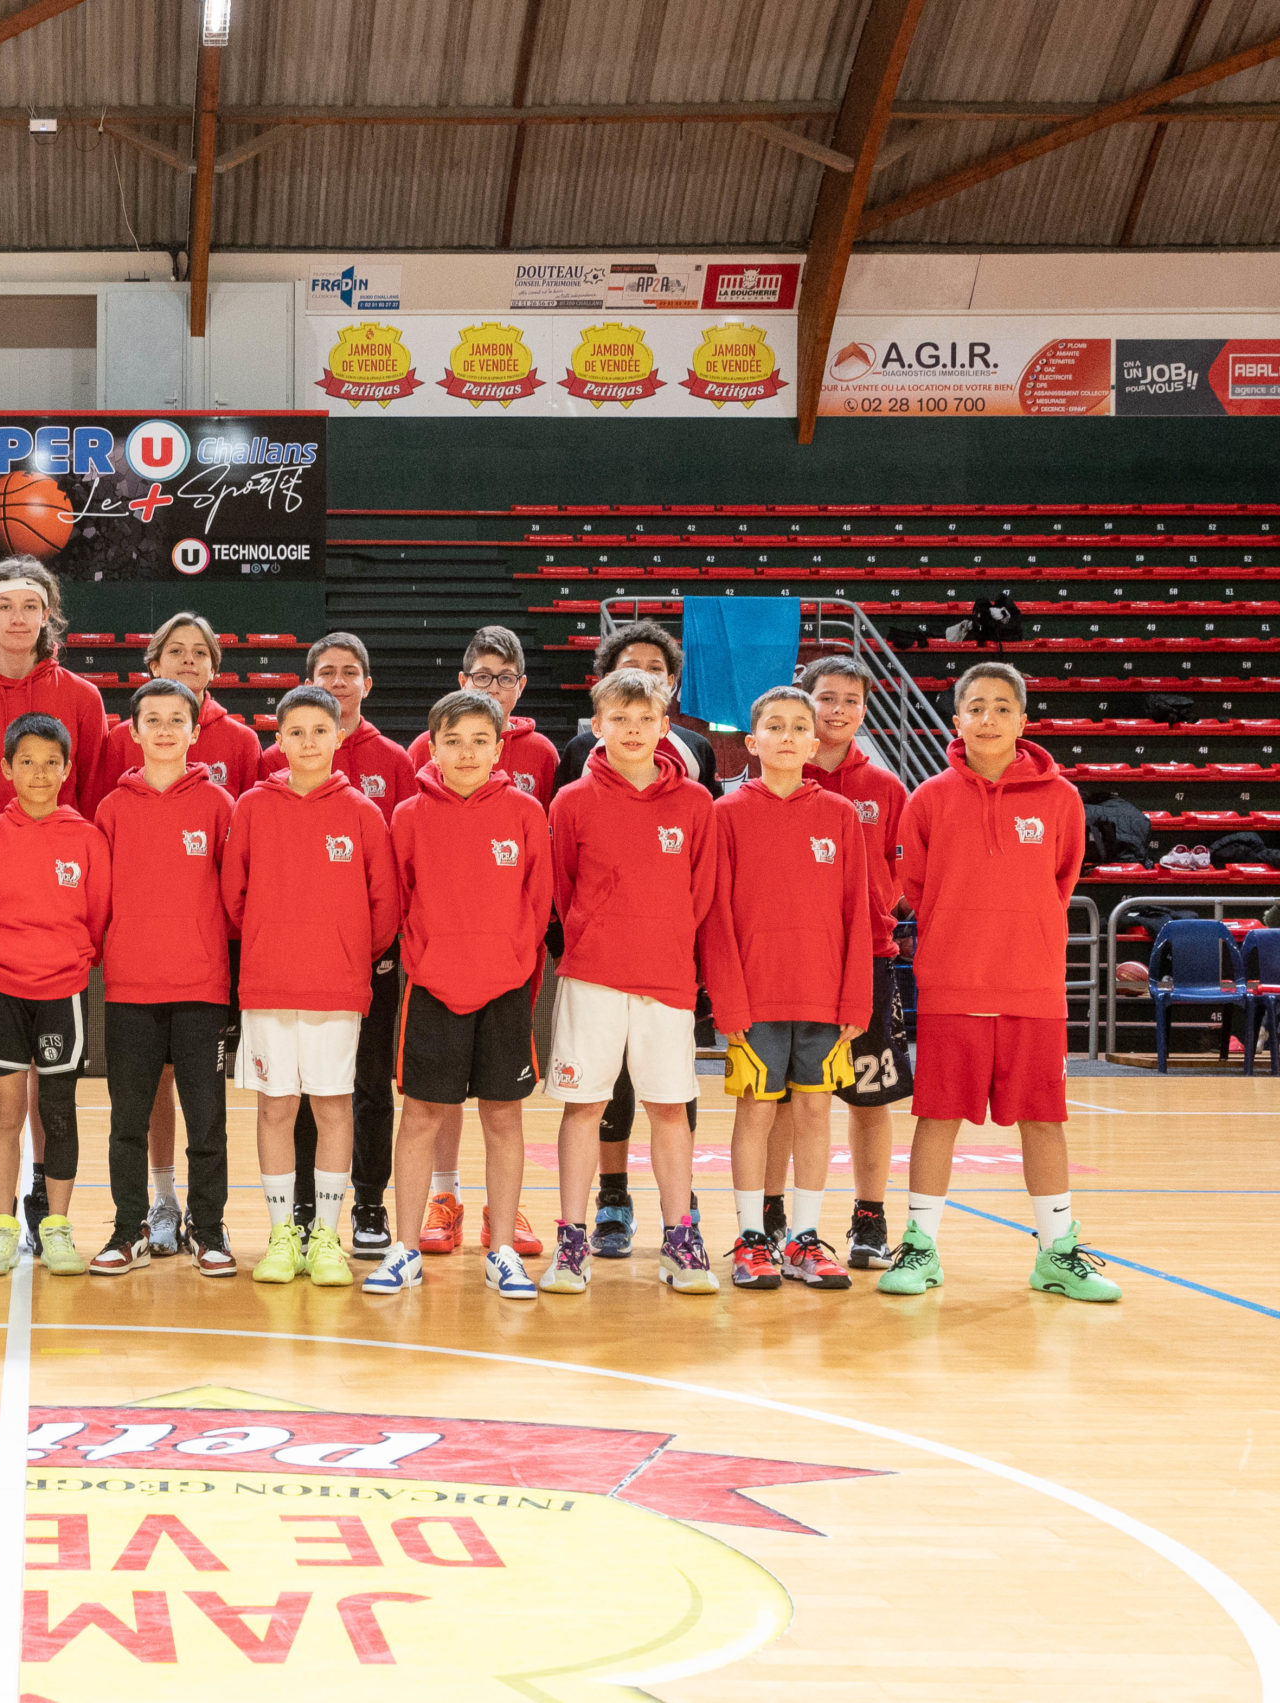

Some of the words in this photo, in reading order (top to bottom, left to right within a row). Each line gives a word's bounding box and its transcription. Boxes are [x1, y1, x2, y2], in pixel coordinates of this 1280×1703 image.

[516, 265, 584, 278] DOUTEAU
[636, 276, 670, 293] AP2A
[347, 342, 392, 357] JAMBON
[468, 342, 513, 357] JAMBON
[590, 343, 634, 357] JAMBON
[711, 343, 756, 357] JAMBON
[881, 341, 999, 369] A.G.I.R.
[341, 359, 354, 372] DE
[357, 356, 398, 372] VENDÉE
[463, 360, 476, 372] DE
[478, 356, 519, 372] VENDÉE
[584, 360, 596, 372] DE
[600, 356, 640, 372] VENDÉE
[706, 360, 718, 372] DE
[721, 356, 762, 372] VENDÉE
[1234, 364, 1280, 377] ABAL
[882, 369, 937, 377] DIAGNOSTICS
[938, 369, 991, 377] IMMOBILIERS
[1124, 368, 1142, 379] UN
[1140, 362, 1187, 384] JOB
[340, 382, 401, 399] Petitgas
[461, 382, 522, 399] Petitgas
[583, 382, 643, 399] Petitgas
[704, 382, 765, 400] Petitgas
[840, 383, 851, 392] LA
[852, 383, 879, 392] VENTE
[881, 383, 894, 392] OU
[895, 383, 906, 392] LA
[908, 383, 951, 392] LOCATION
[952, 383, 963, 392] DE
[965, 383, 992, 392] VOTRE
[994, 383, 1013, 392] BIEN
[1125, 385, 1146, 393] POUR
[1146, 381, 1184, 395] VOUS
[1234, 385, 1266, 395] agence
[861, 398, 882, 412] 02
[888, 398, 910, 412] 28
[917, 397, 948, 412] 100
[953, 397, 985, 412] 700
[141, 437, 173, 468] U
[196, 436, 318, 466] Challans
[57, 477, 130, 524] Le
[177, 464, 312, 535] Sportif
[212, 543, 311, 561] TECHNOLOGIE
[39, 1035, 62, 1048] NETS
[216, 1040, 225, 1072] NIKE
[853, 1047, 899, 1094] 23
[235, 1480, 577, 1513] INDICATION
[279, 1514, 507, 1568] DE
